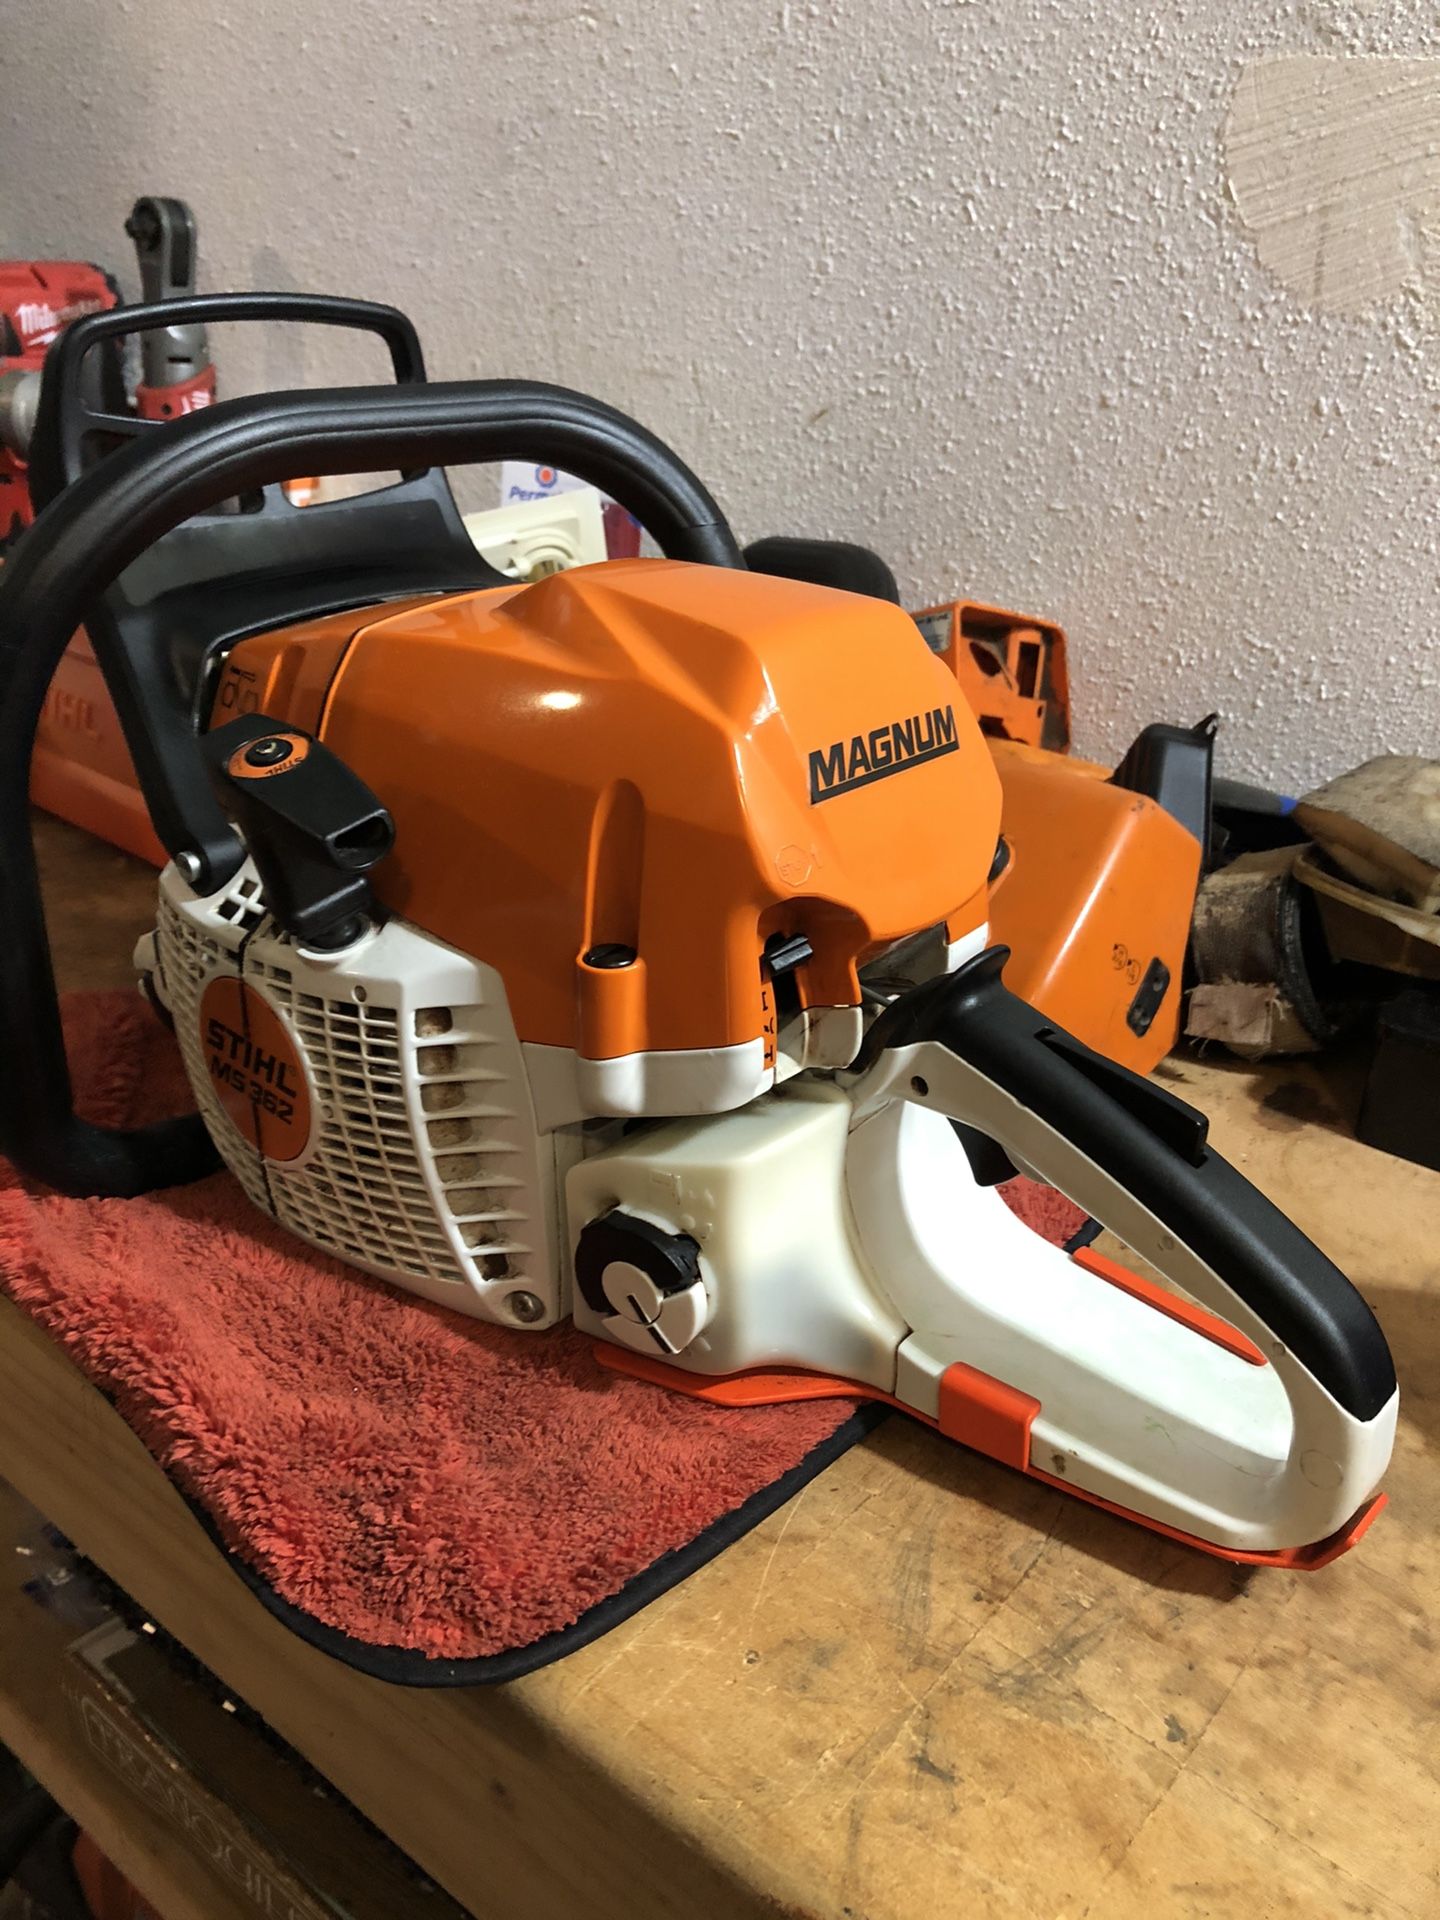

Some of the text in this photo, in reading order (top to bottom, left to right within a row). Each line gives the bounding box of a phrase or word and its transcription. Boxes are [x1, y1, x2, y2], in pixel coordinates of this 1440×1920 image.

[808, 704, 960, 805] MAGNUM
[206, 1017, 298, 1098] STIHL
[210, 1055, 294, 1126] MS 362
